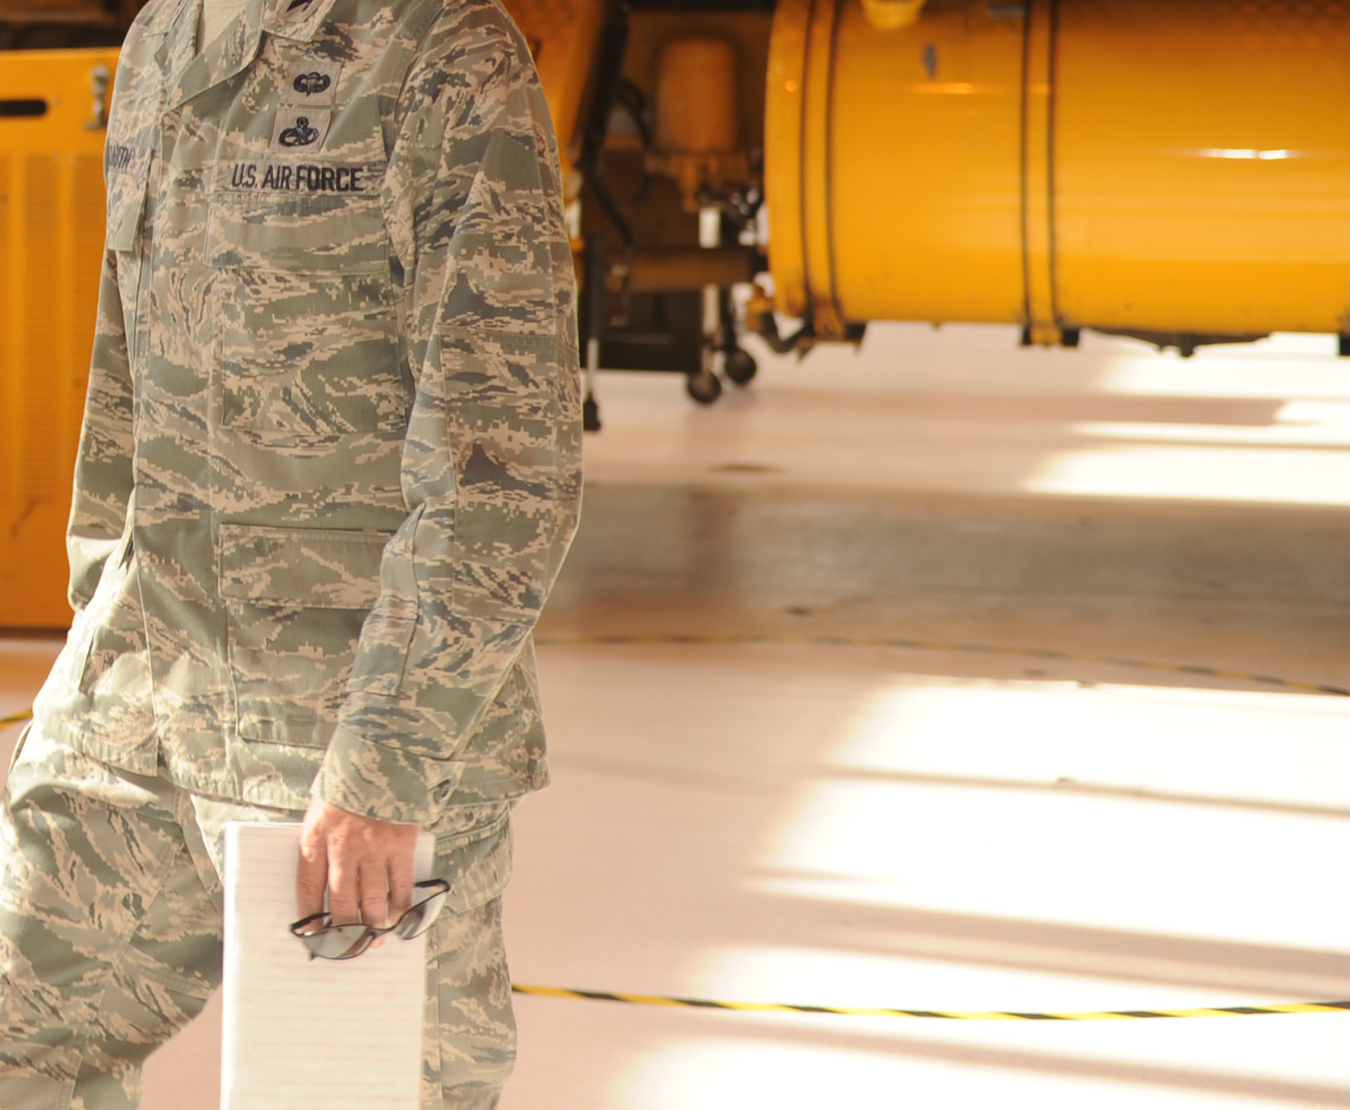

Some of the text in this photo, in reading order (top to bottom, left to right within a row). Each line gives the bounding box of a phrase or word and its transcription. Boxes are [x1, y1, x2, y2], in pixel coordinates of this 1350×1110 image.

[231, 163, 364, 192] U.S. AIR FORCE
